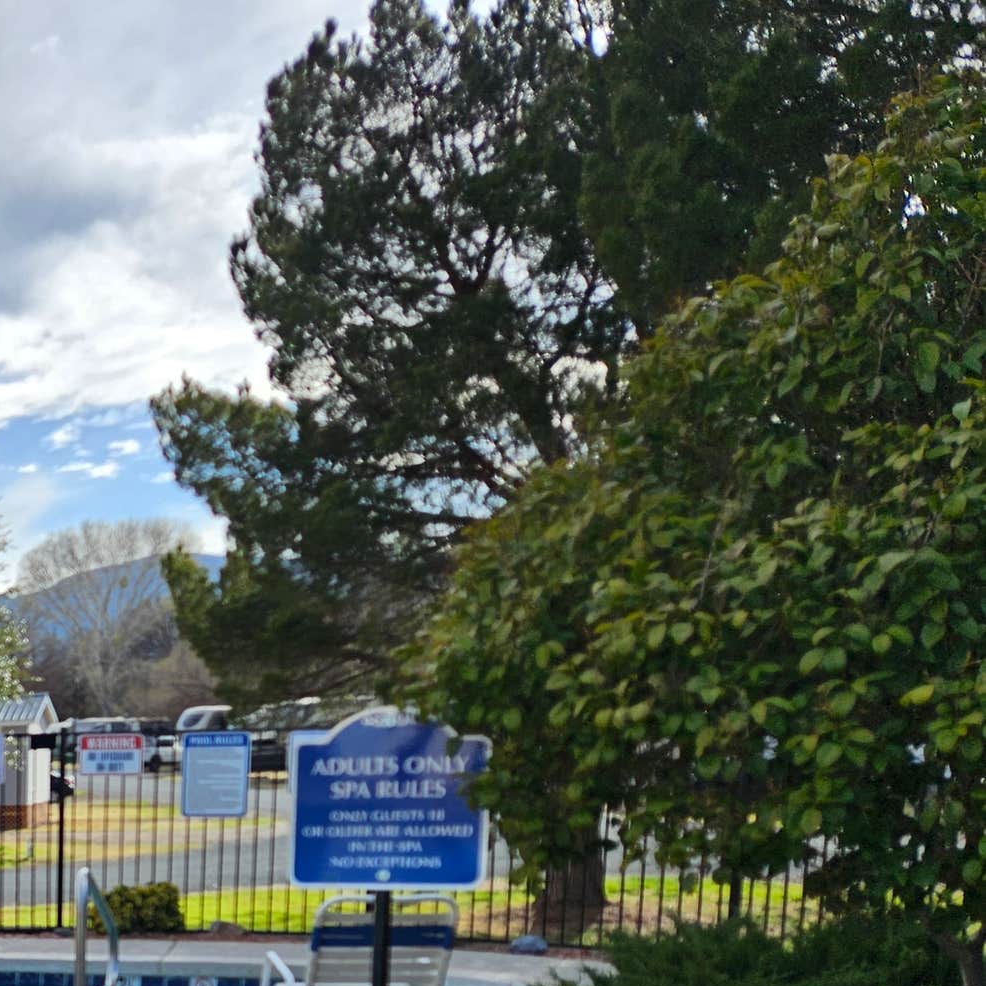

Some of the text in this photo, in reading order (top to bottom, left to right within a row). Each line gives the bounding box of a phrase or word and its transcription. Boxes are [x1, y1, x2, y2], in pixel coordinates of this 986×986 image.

[312, 756, 470, 776] ADULTS ONLY
[330, 780, 447, 799] SPA RULES
[329, 810, 368, 822] ONLY
[404, 825, 474, 838] ALLOWED
[396, 840, 423, 852] SPA
